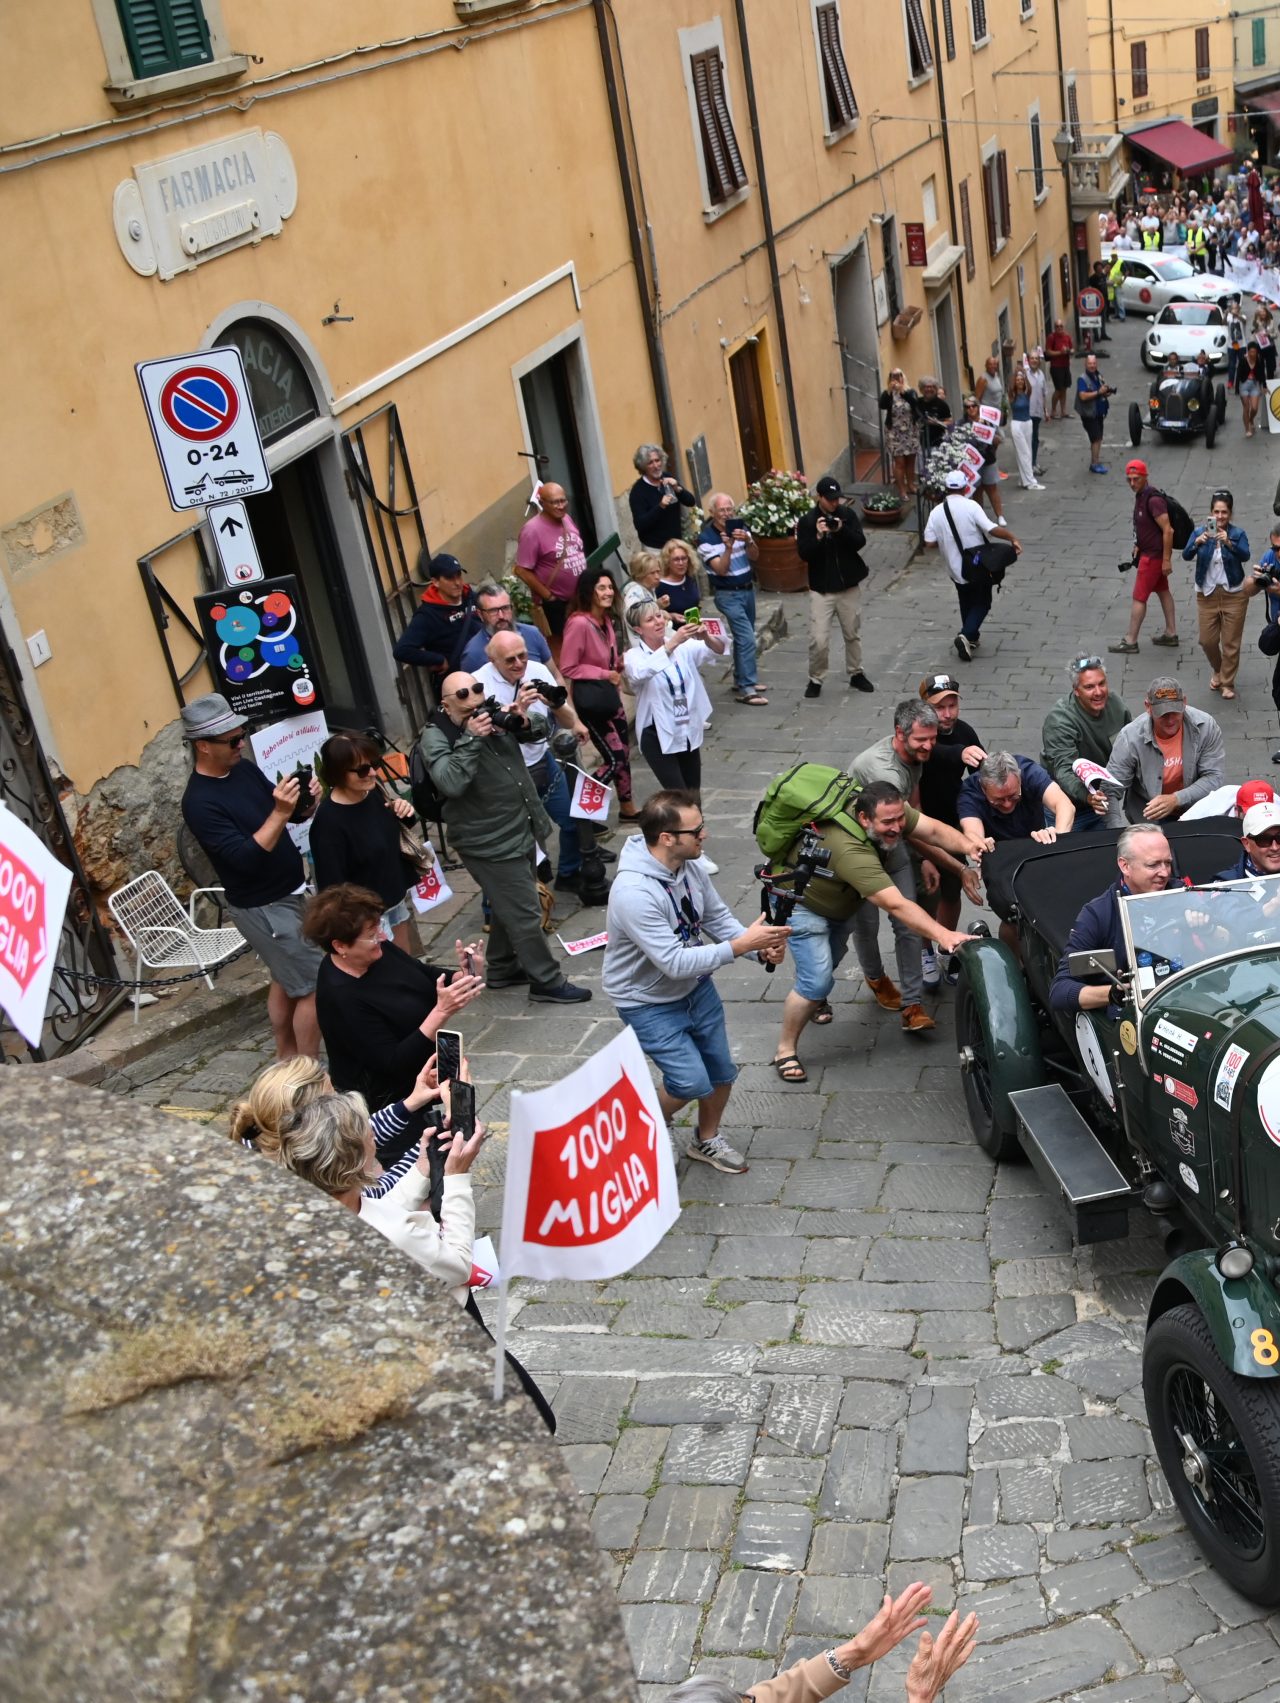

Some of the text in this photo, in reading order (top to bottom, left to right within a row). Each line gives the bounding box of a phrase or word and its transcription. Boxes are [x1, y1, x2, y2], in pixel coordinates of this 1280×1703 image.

[158, 151, 256, 213] FARMACIA
[187, 441, 239, 466] 0-24
[236, 485, 254, 495] 2017
[262, 725, 320, 760] Laboratori artistici
[1088, 1047, 1099, 1076] 8
[1226, 1051, 1242, 1069] 100
[560, 1098, 627, 1179] 1000
[538, 1153, 649, 1237] MIGLIA
[1251, 1328, 1279, 1366] 8
